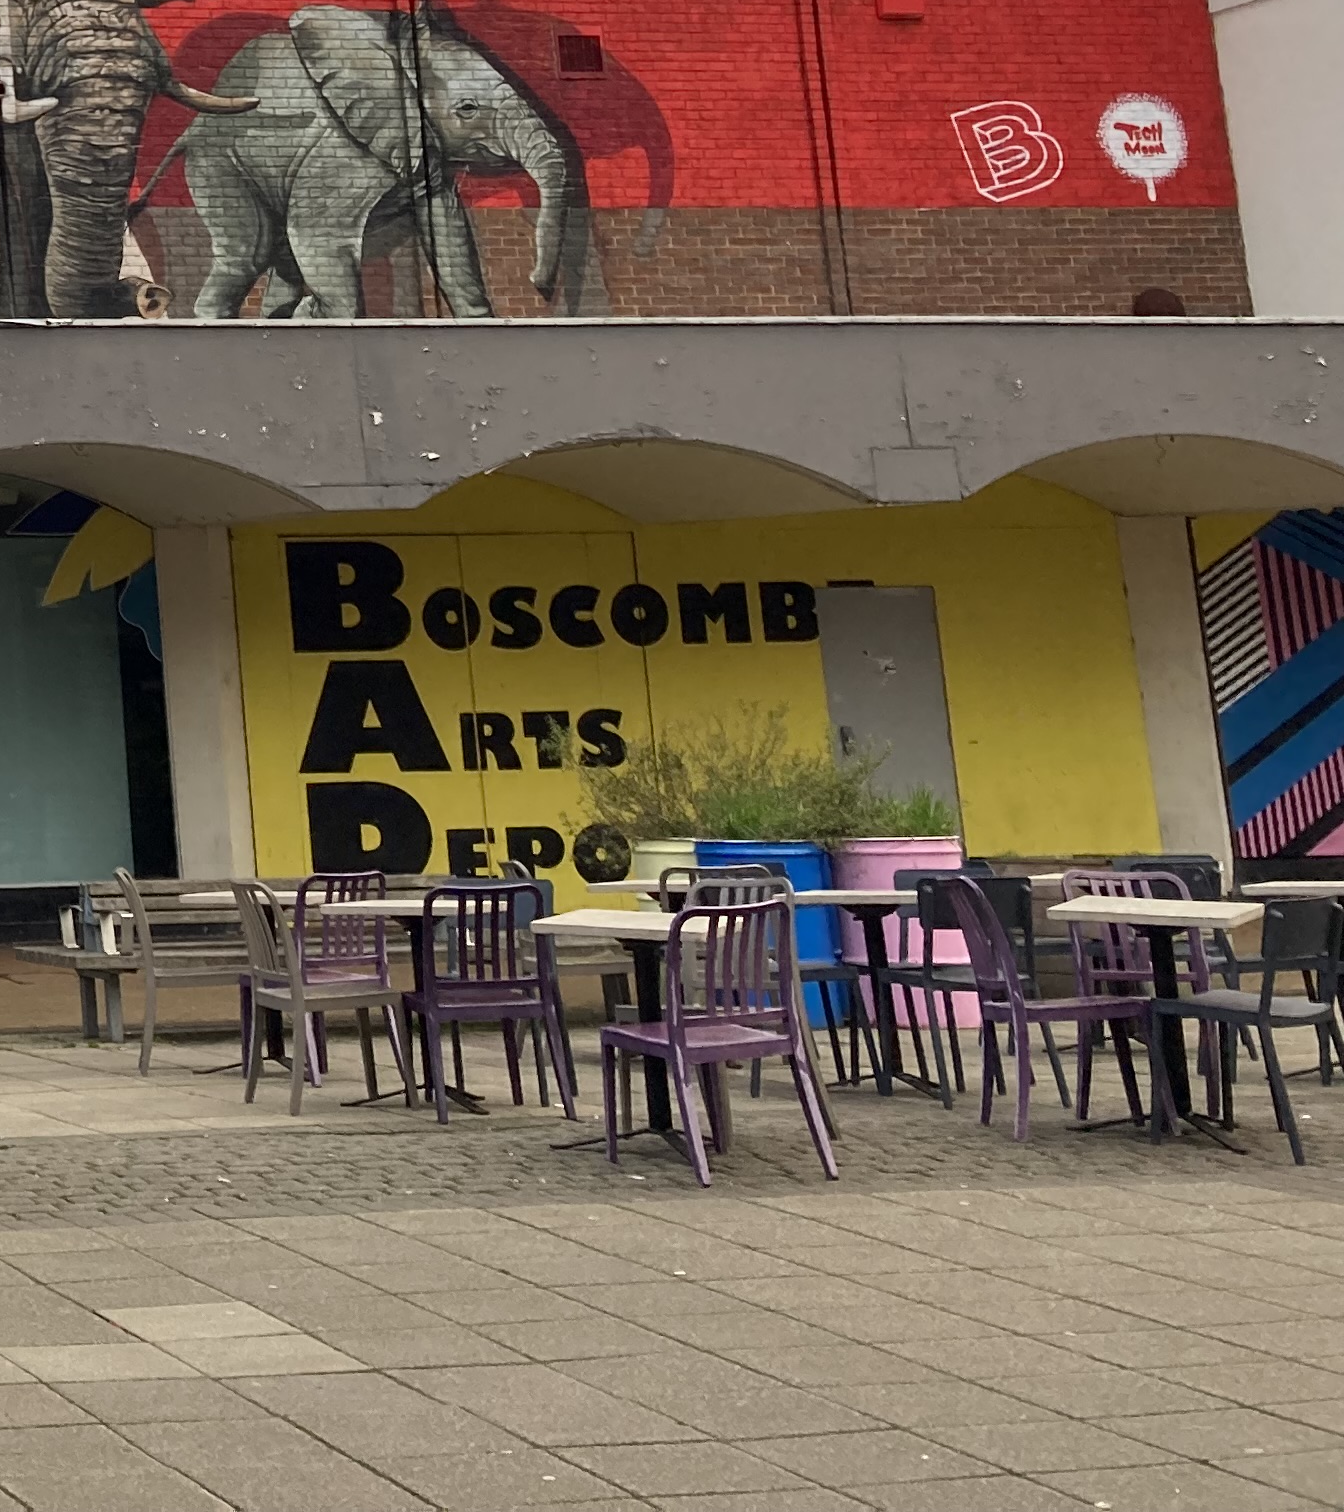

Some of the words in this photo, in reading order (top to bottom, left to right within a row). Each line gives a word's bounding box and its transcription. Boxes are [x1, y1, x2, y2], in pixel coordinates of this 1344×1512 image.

[950, 100, 1064, 203] B
[285, 541, 874, 653] BOSCOMB
[299, 660, 628, 774] ARTS
